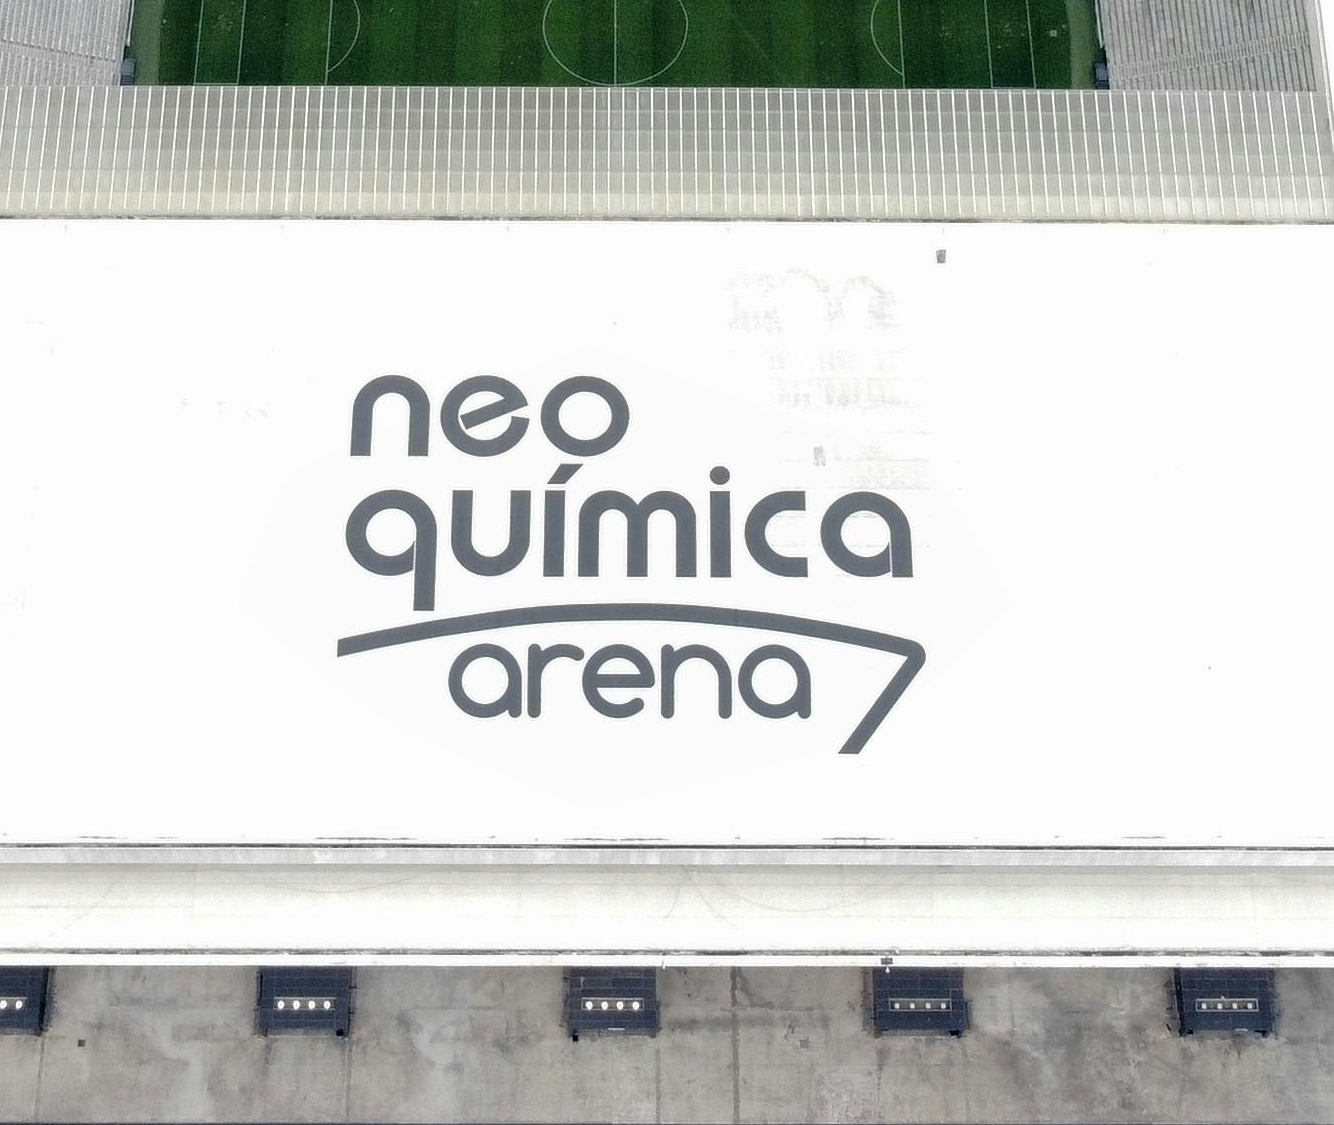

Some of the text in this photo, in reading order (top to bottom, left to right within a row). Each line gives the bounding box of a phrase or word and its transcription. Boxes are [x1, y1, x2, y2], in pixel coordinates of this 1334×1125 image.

[350, 375, 630, 457] neo
[345, 464, 914, 612] química
[448, 644, 812, 719] arena
